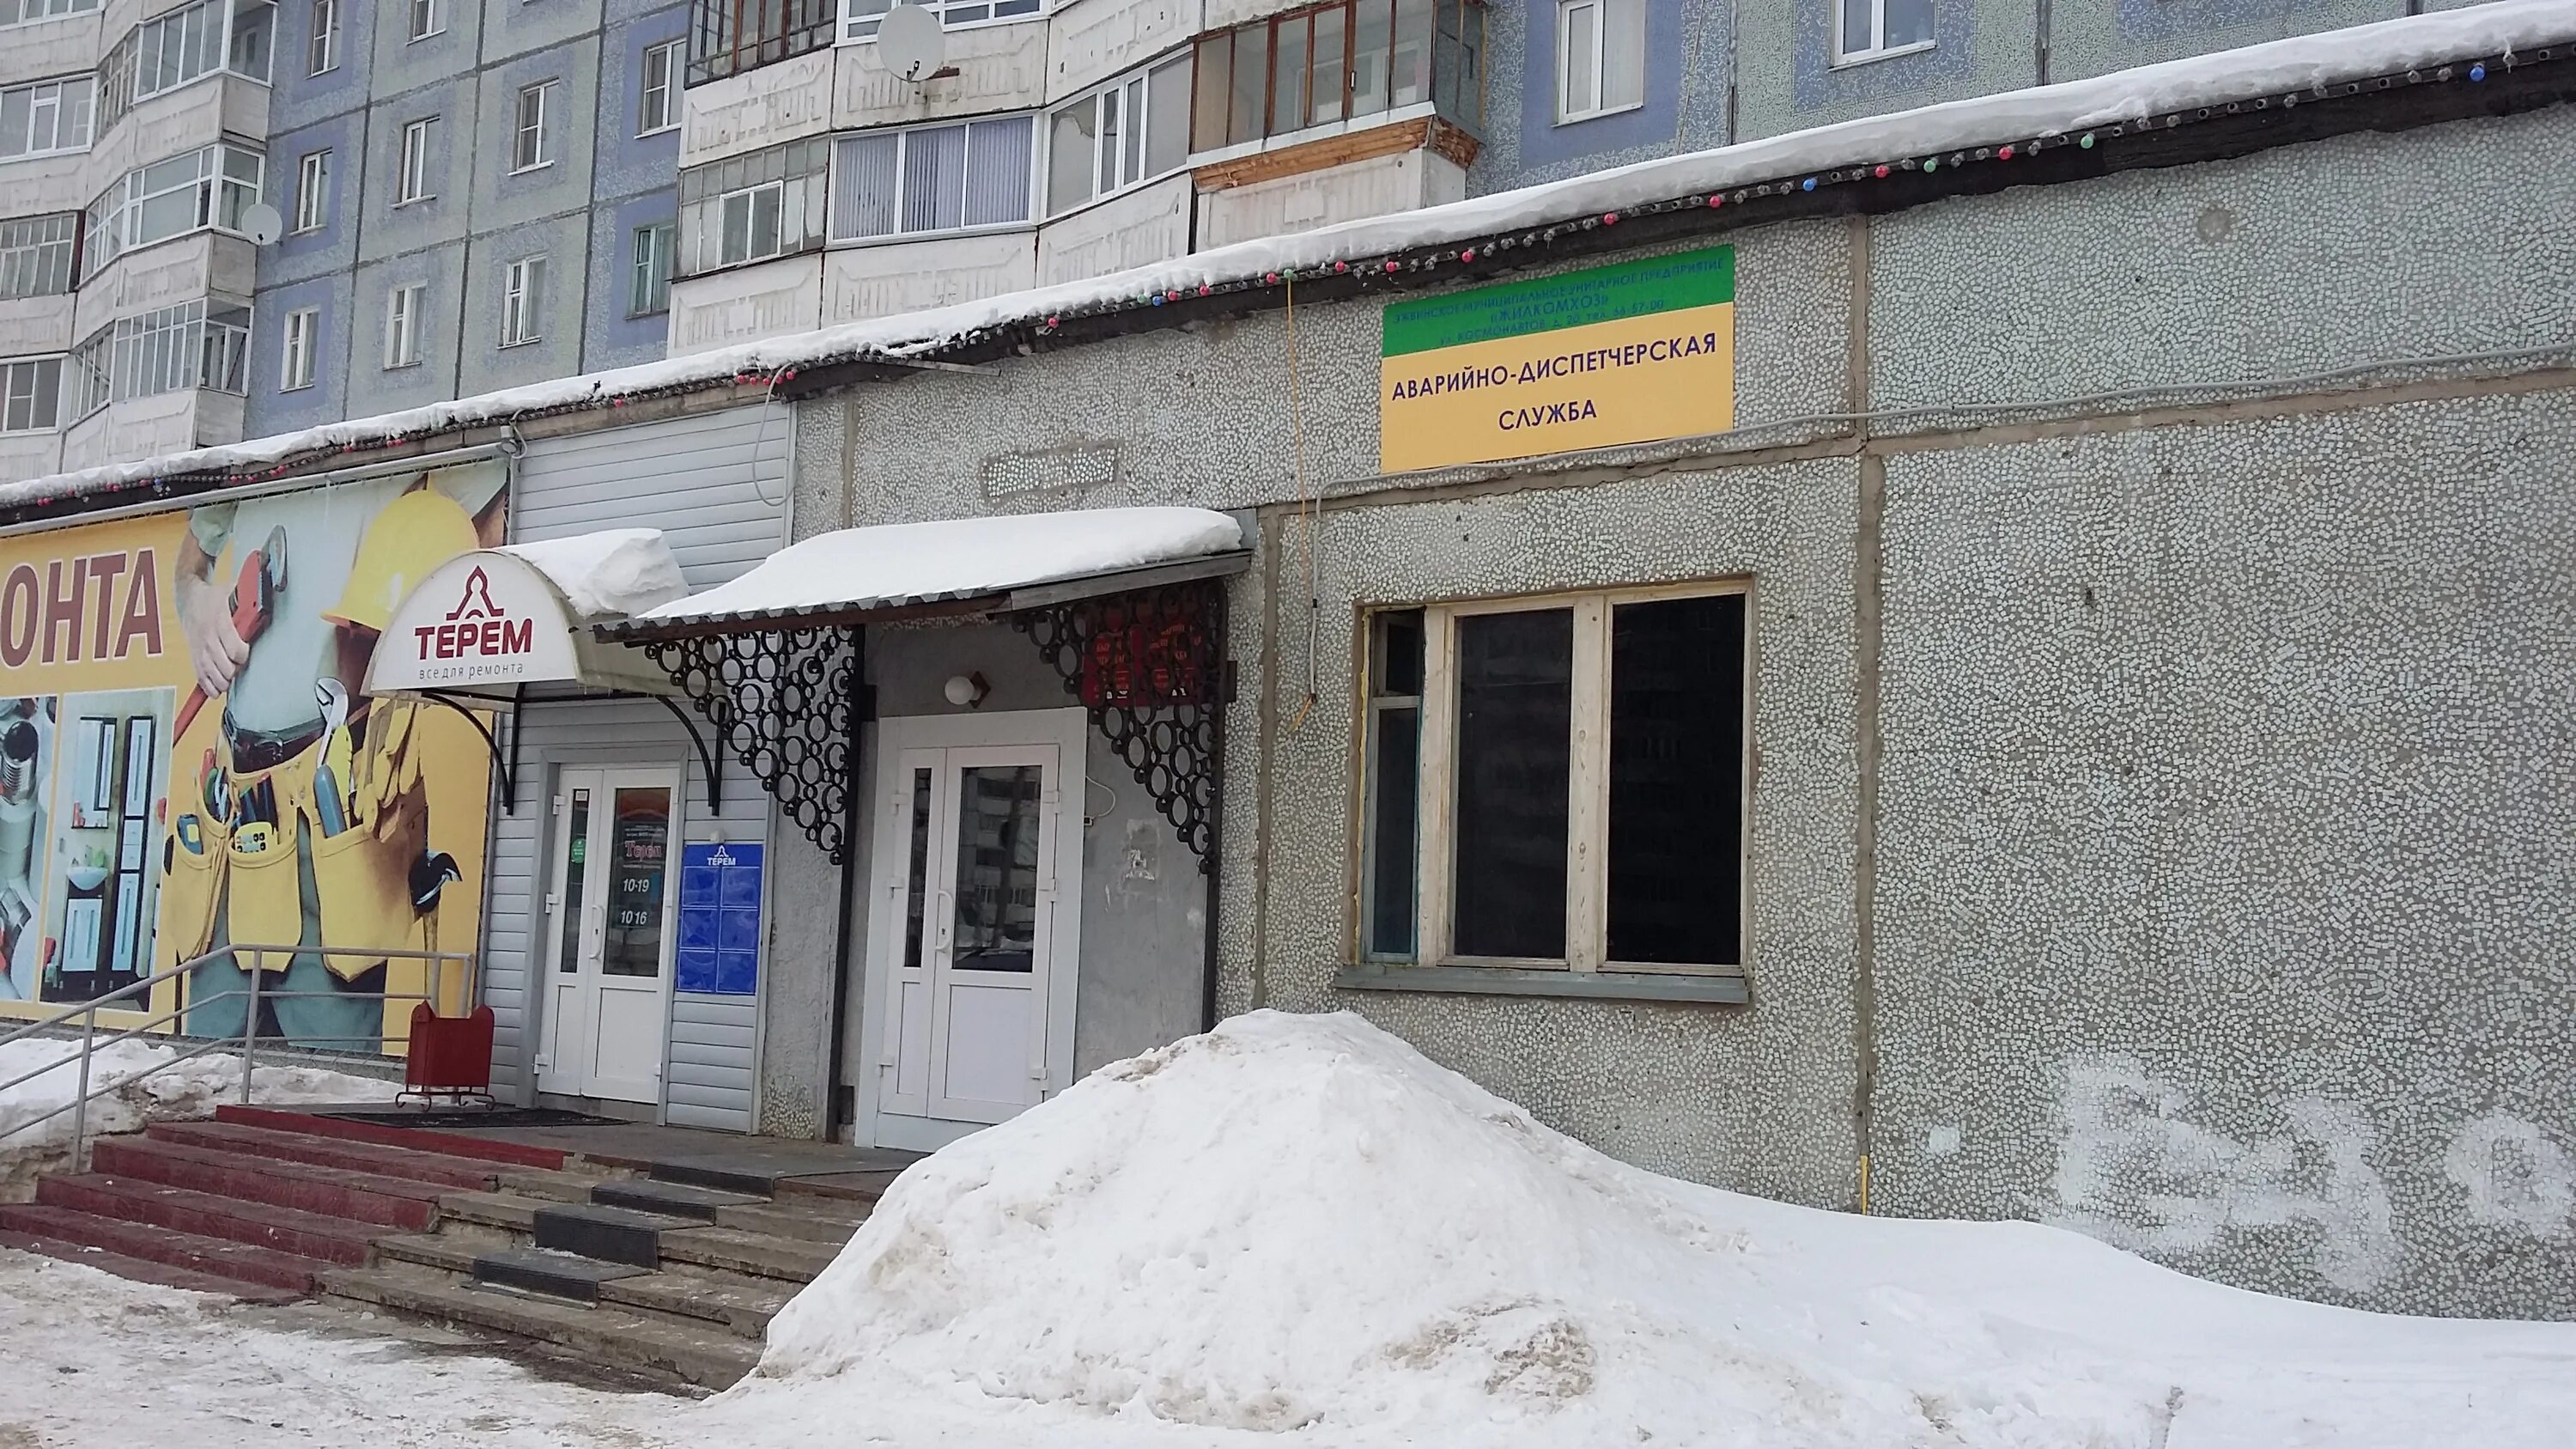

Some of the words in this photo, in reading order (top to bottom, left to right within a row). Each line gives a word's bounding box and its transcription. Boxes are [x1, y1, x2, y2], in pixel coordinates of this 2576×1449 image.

[1391, 332, 1716, 401] АВАРИЙНО-ДИСПЕТЧЕРСКАЯ
[1498, 399, 1597, 430] СЛУЖБА
[1, 550, 161, 667] ОНТА
[415, 618, 533, 661] ТЕРЕМ
[419, 667, 440, 679] все
[441, 666, 464, 679] для
[468, 661, 524, 679] ремонта
[708, 857, 736, 866] ТЕРЕМ
